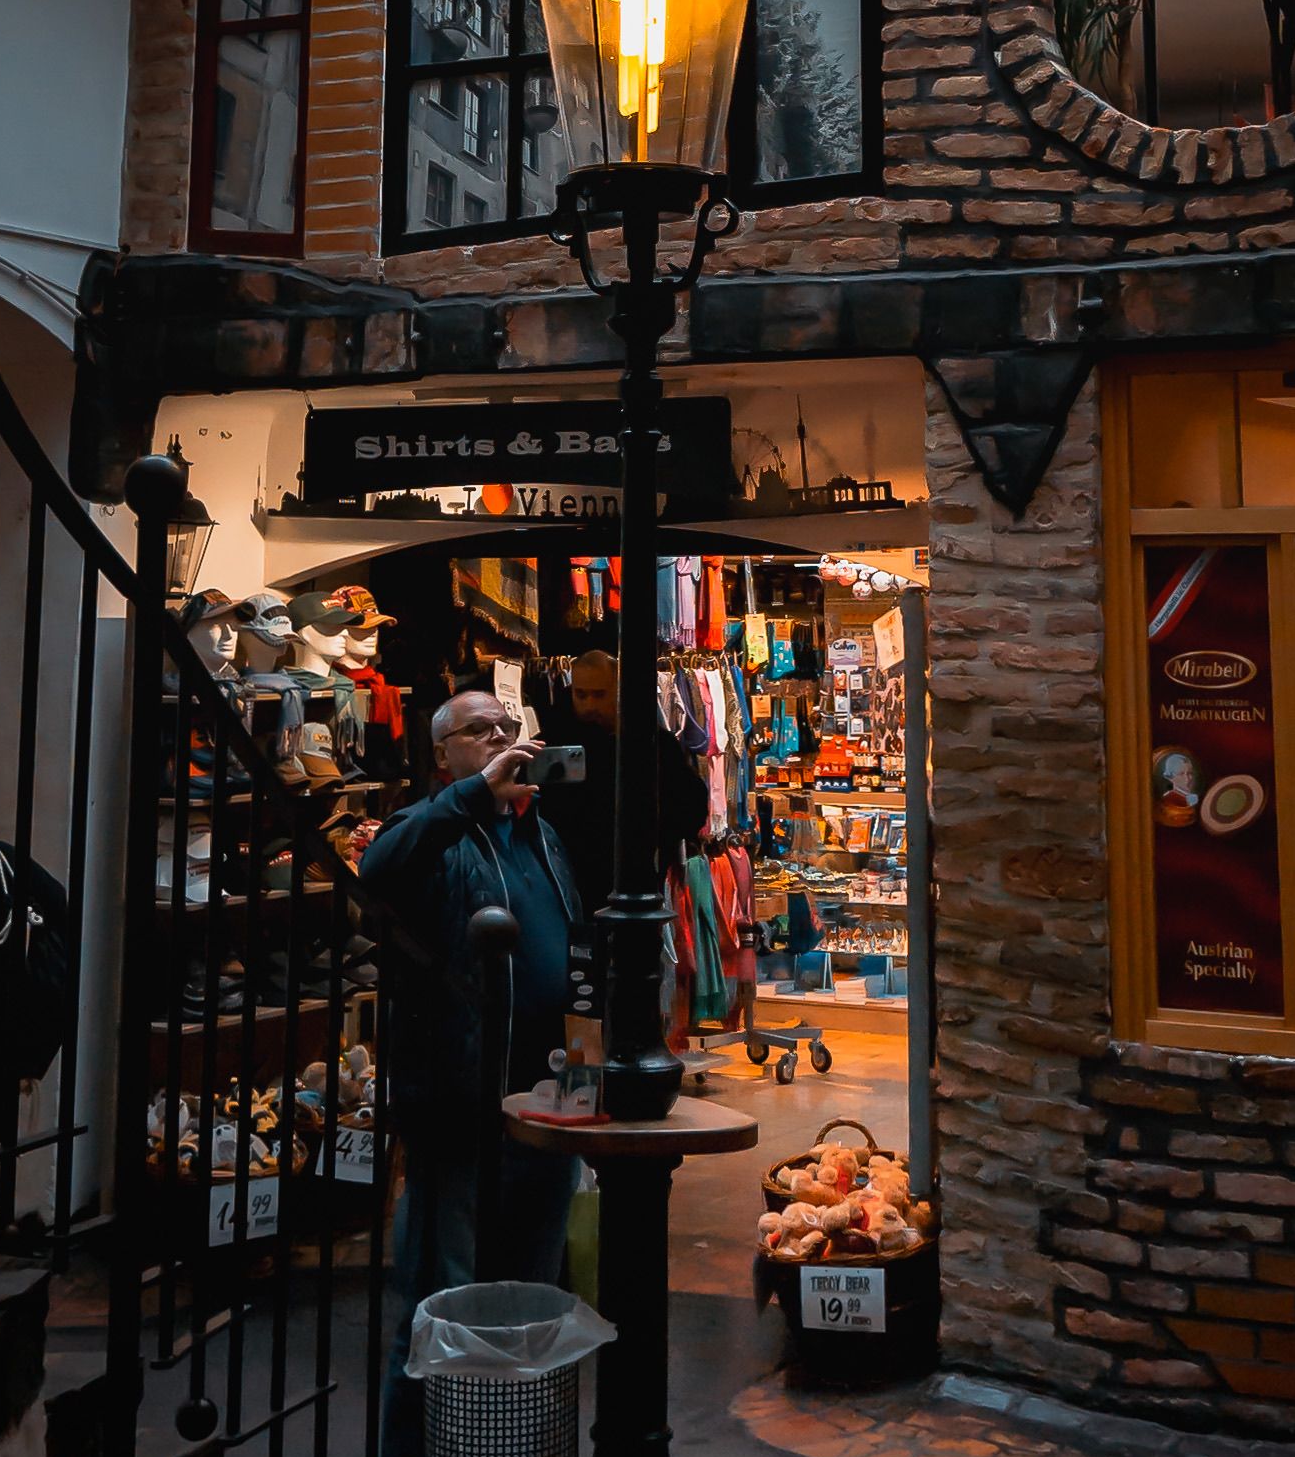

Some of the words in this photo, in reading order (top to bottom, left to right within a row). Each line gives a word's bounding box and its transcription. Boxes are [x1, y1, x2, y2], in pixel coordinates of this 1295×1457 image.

[354, 433, 496, 460] Shirts
[506, 431, 542, 455] &
[554, 430, 673, 455] Bas
[517, 486, 625, 518] Vienn
[1173, 659, 1243, 678] Mirabell
[1160, 703, 1265, 721] MOZARTKUGELN
[1187, 940, 1254, 958] Austrian
[1185, 960, 1256, 985] Specialty
[811, 1274, 842, 1292] TEDDY
[845, 1275, 871, 1294] BEAR
